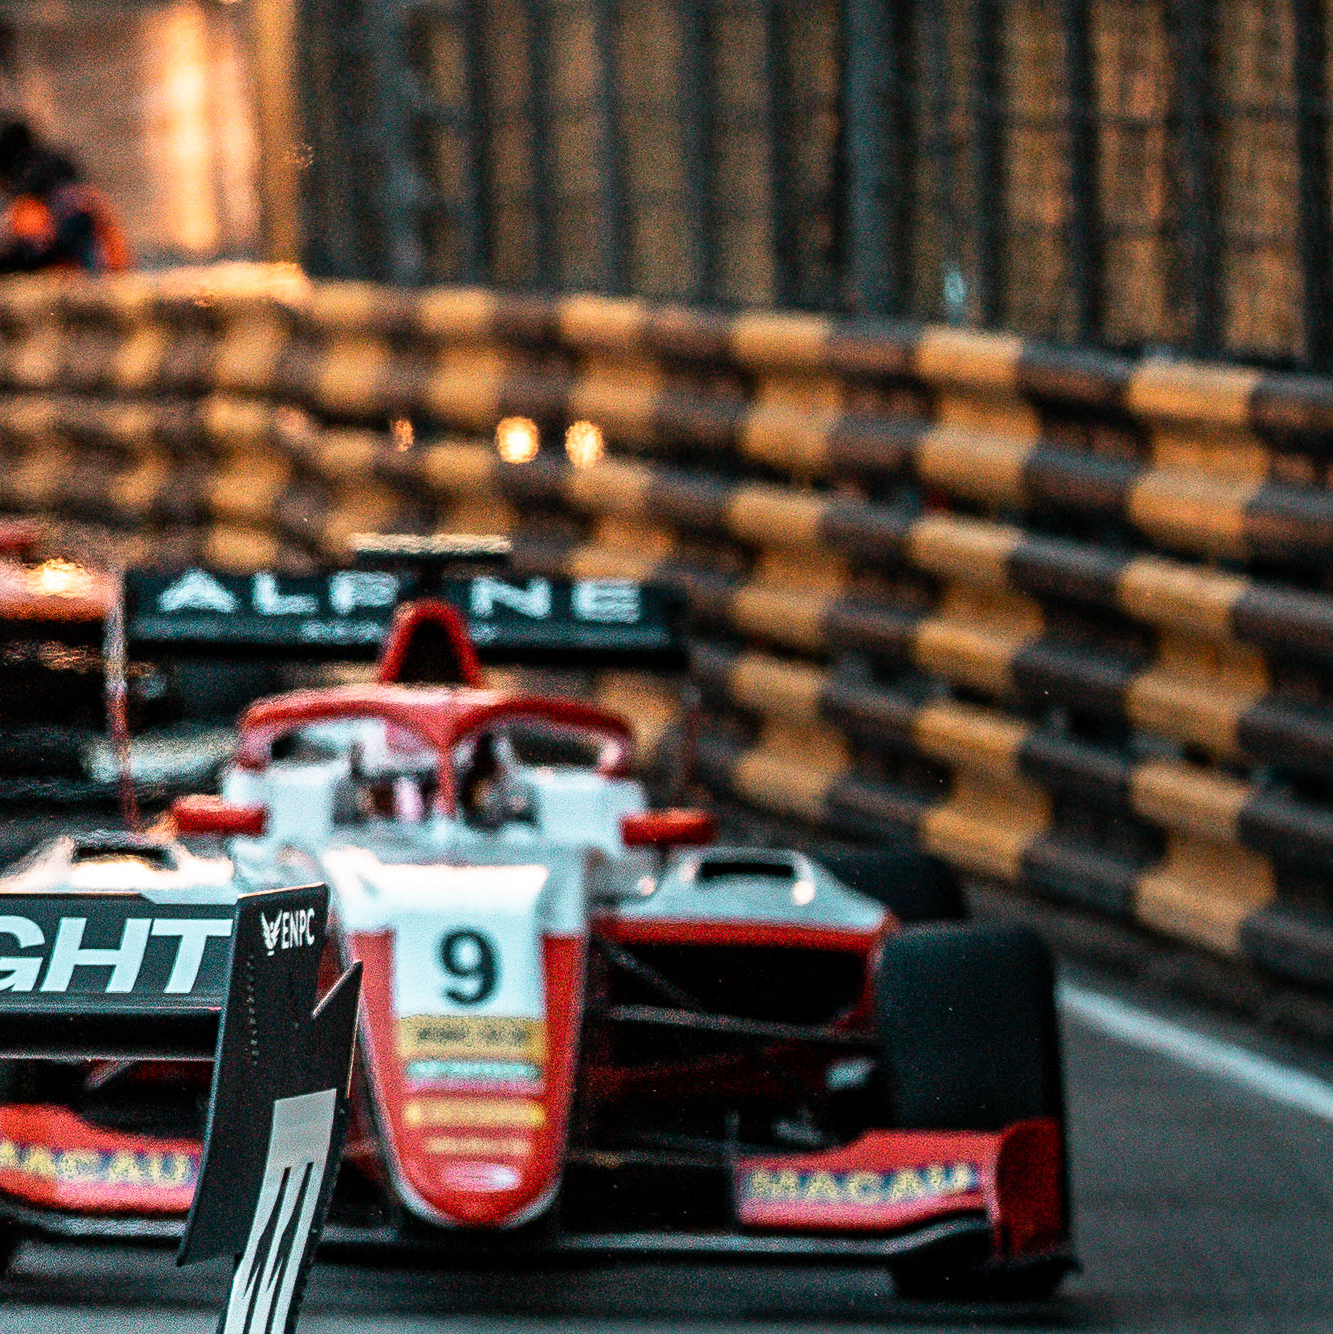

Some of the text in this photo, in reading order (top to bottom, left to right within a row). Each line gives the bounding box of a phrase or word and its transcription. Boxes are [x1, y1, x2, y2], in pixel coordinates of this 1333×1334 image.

[157, 567, 641, 624] ALPNE
[282, 908, 315, 950] ENPC
[438, 926, 499, 1005] 9
[749, 1162, 974, 1205] MACAU
